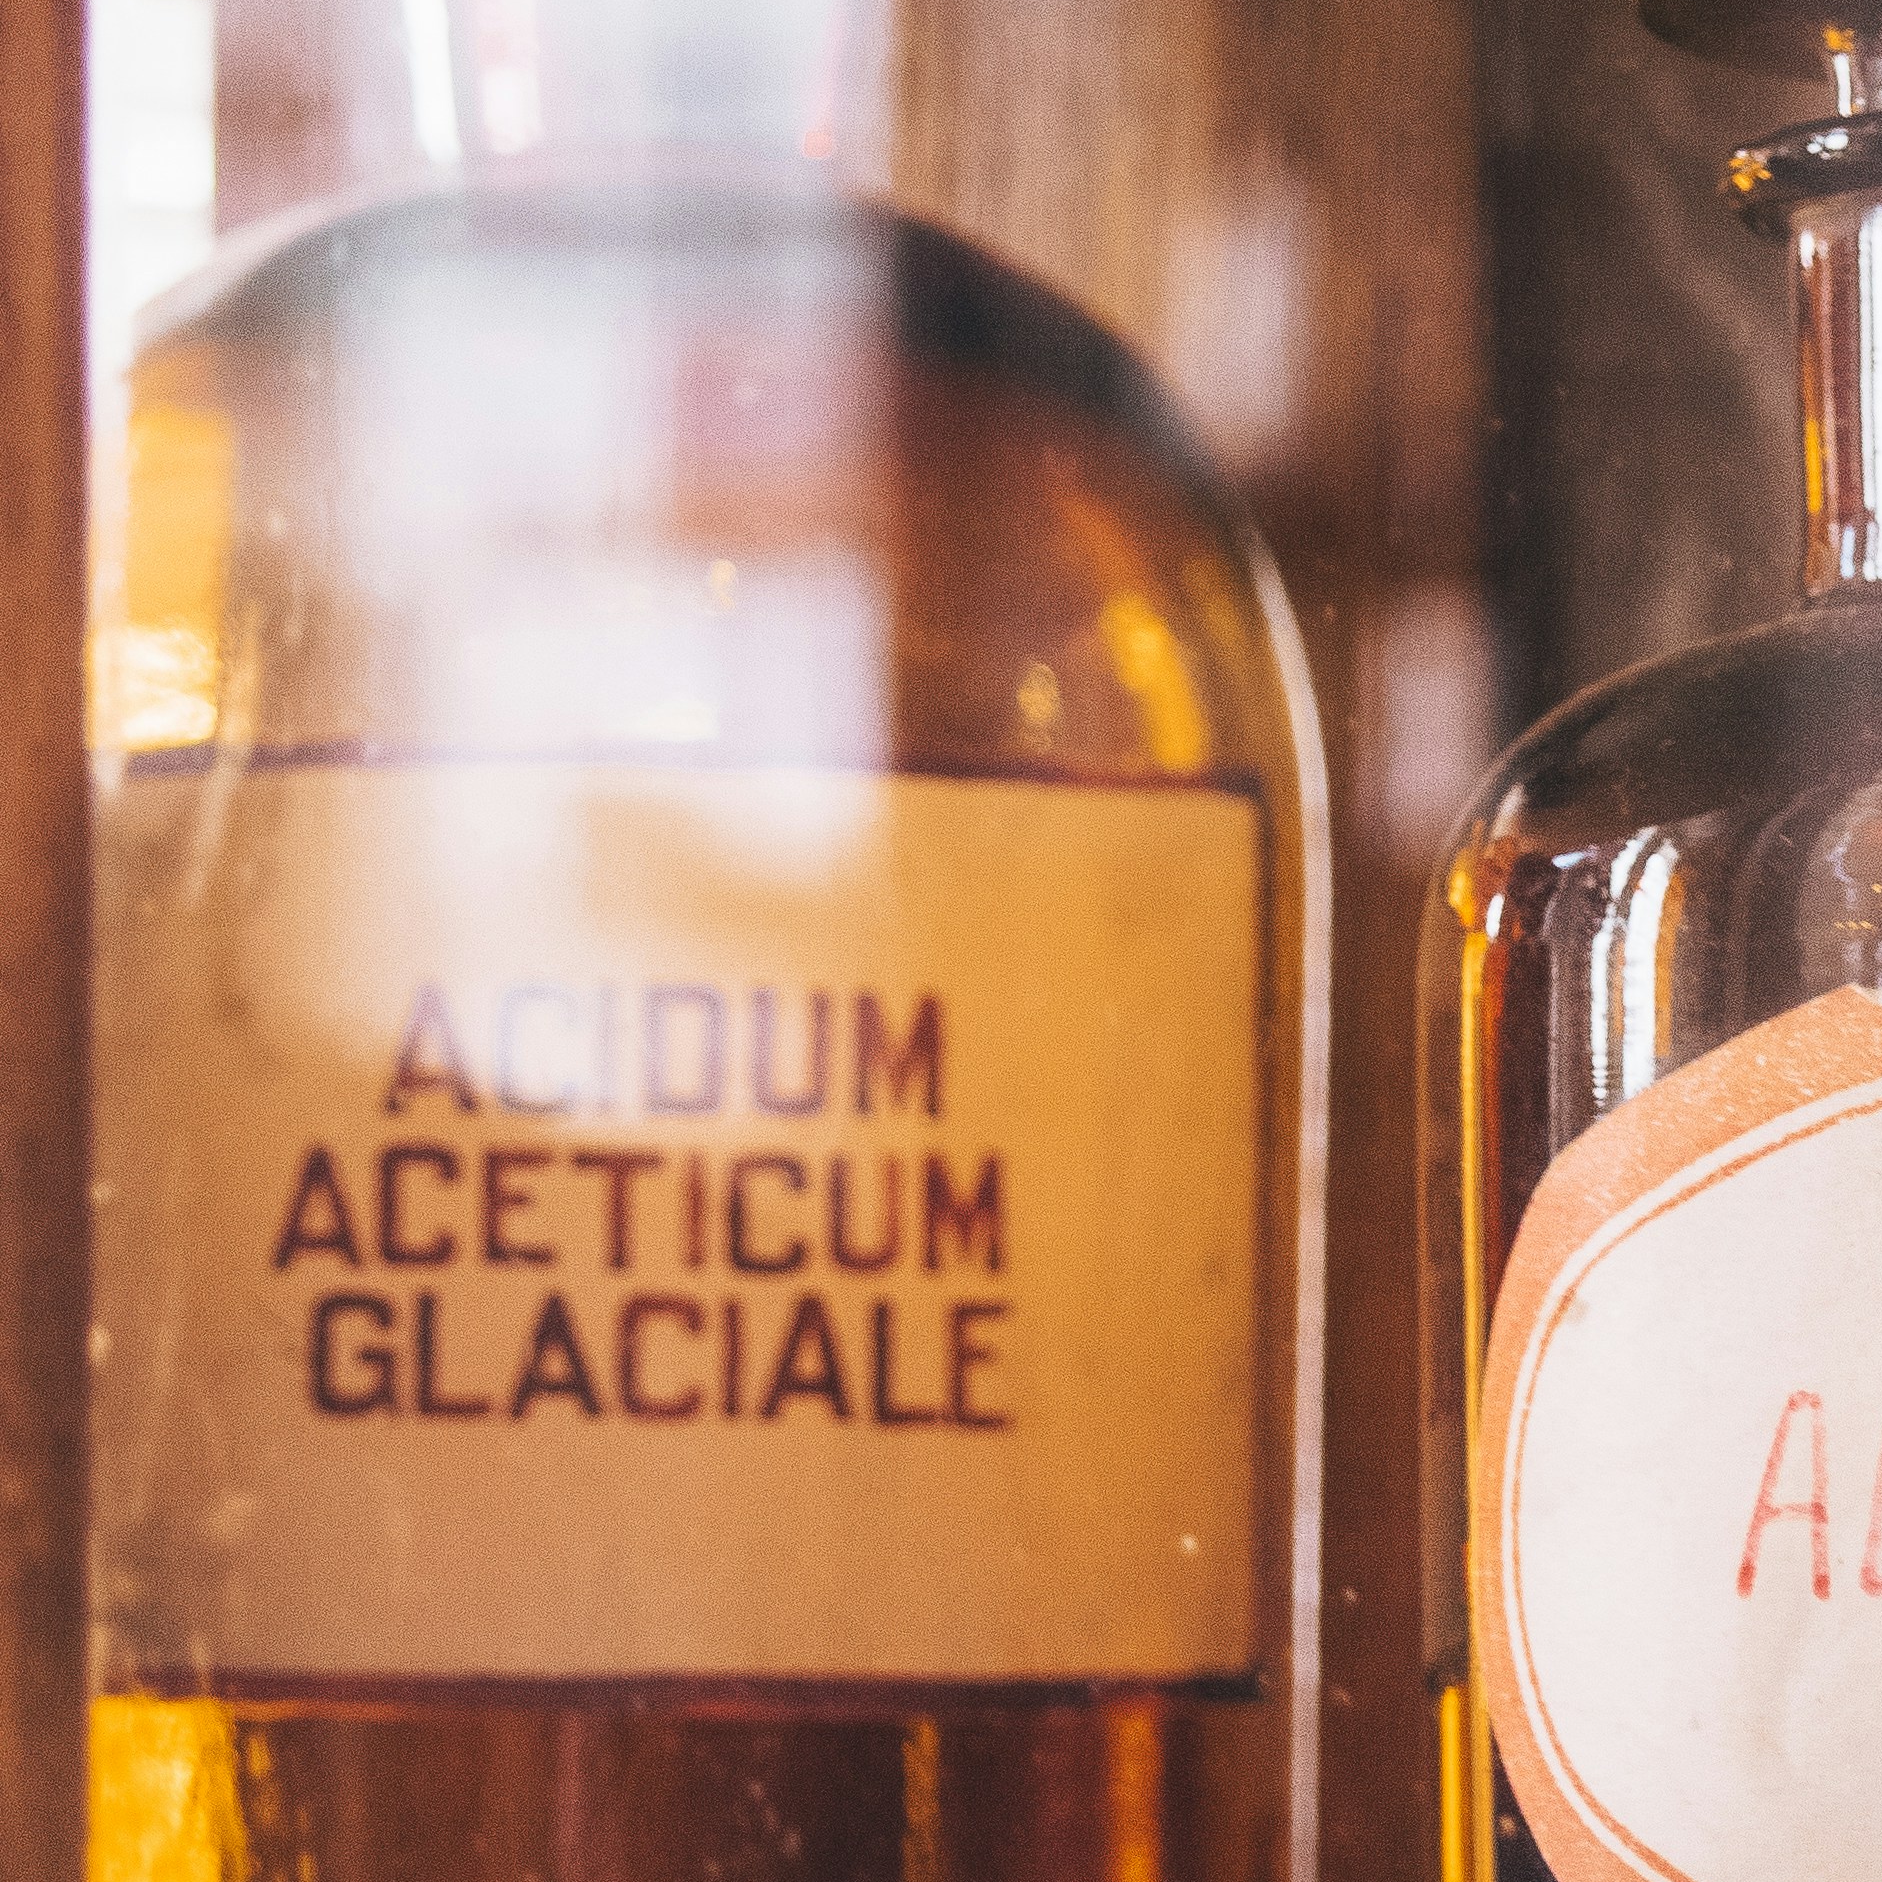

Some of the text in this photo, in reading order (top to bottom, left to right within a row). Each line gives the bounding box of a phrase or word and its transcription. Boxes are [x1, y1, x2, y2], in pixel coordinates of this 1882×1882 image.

[383, 983, 944, 1117] ACIDUM
[274, 1144, 1006, 1273] ACETICUM
[309, 1293, 1012, 1432] GLACIALE
